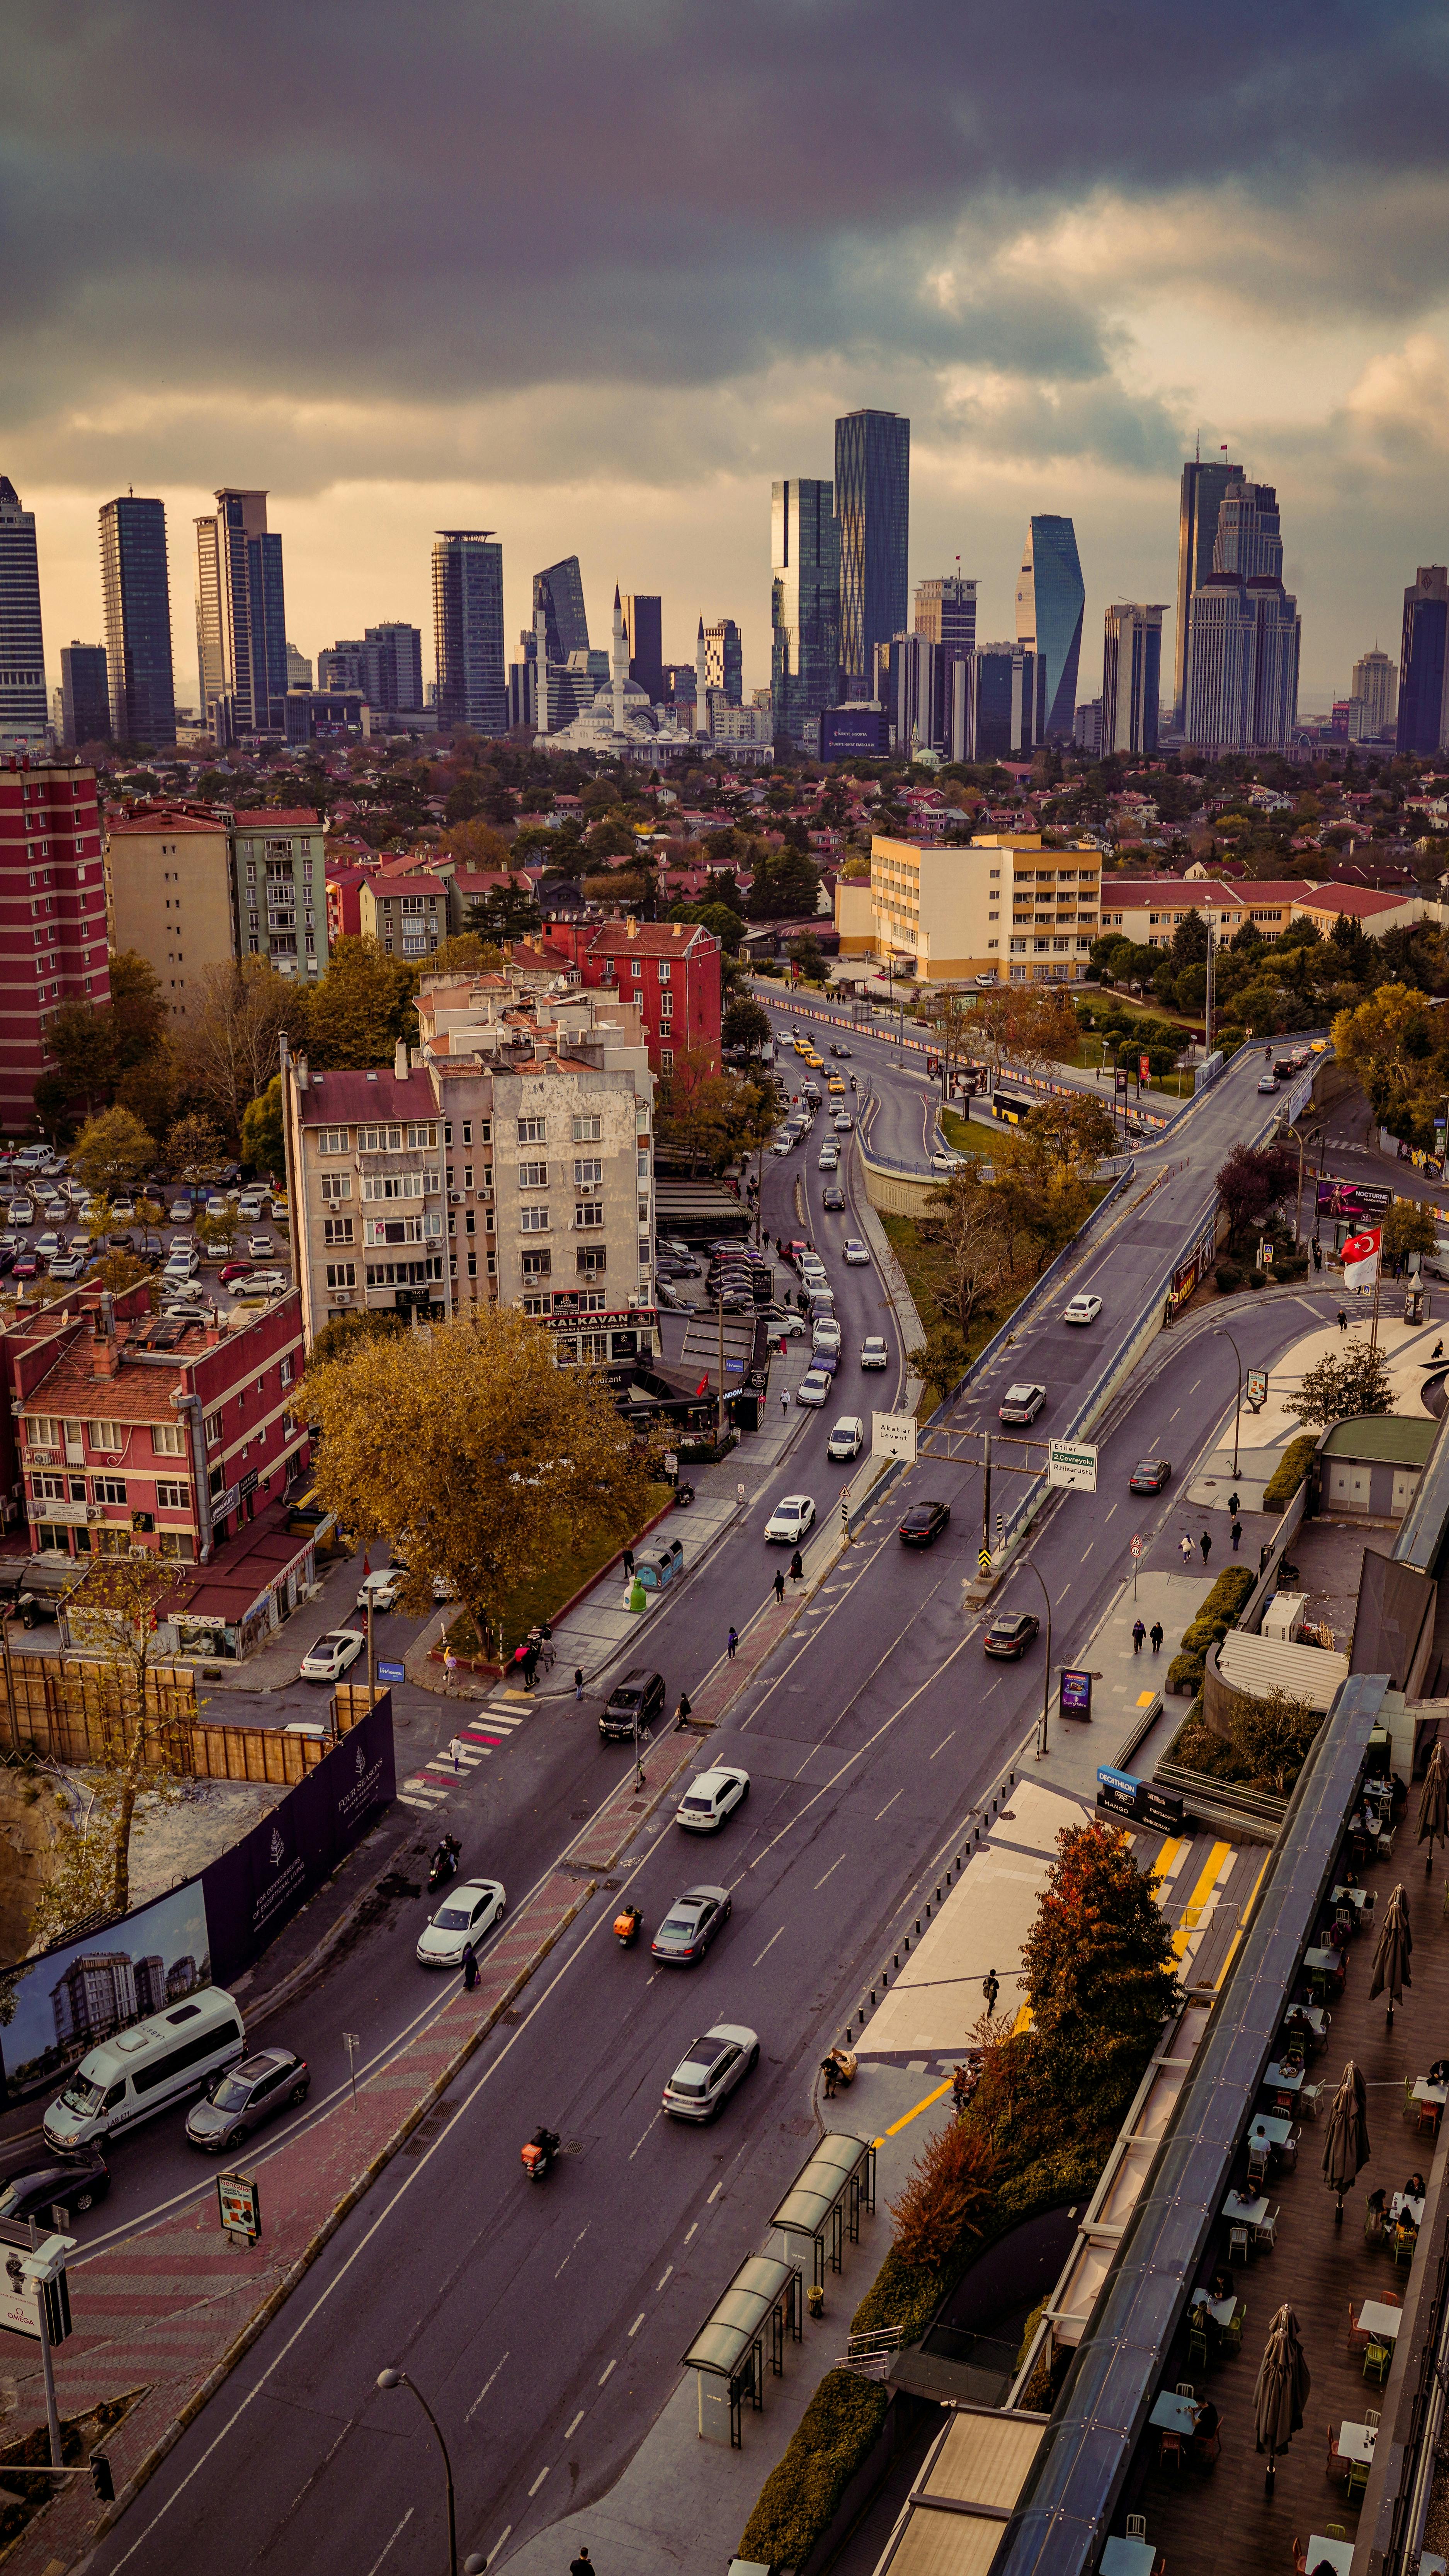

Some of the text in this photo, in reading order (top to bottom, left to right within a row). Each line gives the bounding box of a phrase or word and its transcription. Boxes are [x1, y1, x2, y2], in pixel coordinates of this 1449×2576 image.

[1355, 1191, 1388, 1200] NOCTURNE
[547, 1314, 628, 1327] KALKAVAN
[717, 1388, 743, 1401] RNDOM
[880, 1425, 911, 1434] Akatlar
[880, 1432, 908, 1442] Levent
[1054, 1444, 1077, 1452] Etiler
[1054, 1454, 1093, 1466] 2.Çevreyolu
[1054, 1464, 1093, 1476] R.Hisarüstü
[213, 1501, 226, 1517] AKIMSAN
[273, 1543, 315, 1592] ETİLER VETERİNER
[338, 1788, 359, 1811] FOUR
[357, 1758, 383, 1787] SEASONS
[1099, 1772, 1135, 1793] DECATHLON
[344, 1797, 358, 1813] PRIVATE
[359, 1773, 379, 1797] RESIDENCES
[1104, 1800, 1128, 1814] MANGO
[1147, 1818, 1170, 1832] VAKKORAMA
[257, 1856, 302, 1906] FOR CONNOISSEURS
[253, 1861, 304, 1920] OF EXCEPTIONAL LIVING
[107, 2111, 131, 2128] LAB 671
[219, 2178, 252, 2193] Gencallar
[7, 2312, 35, 2326] OMEGA
